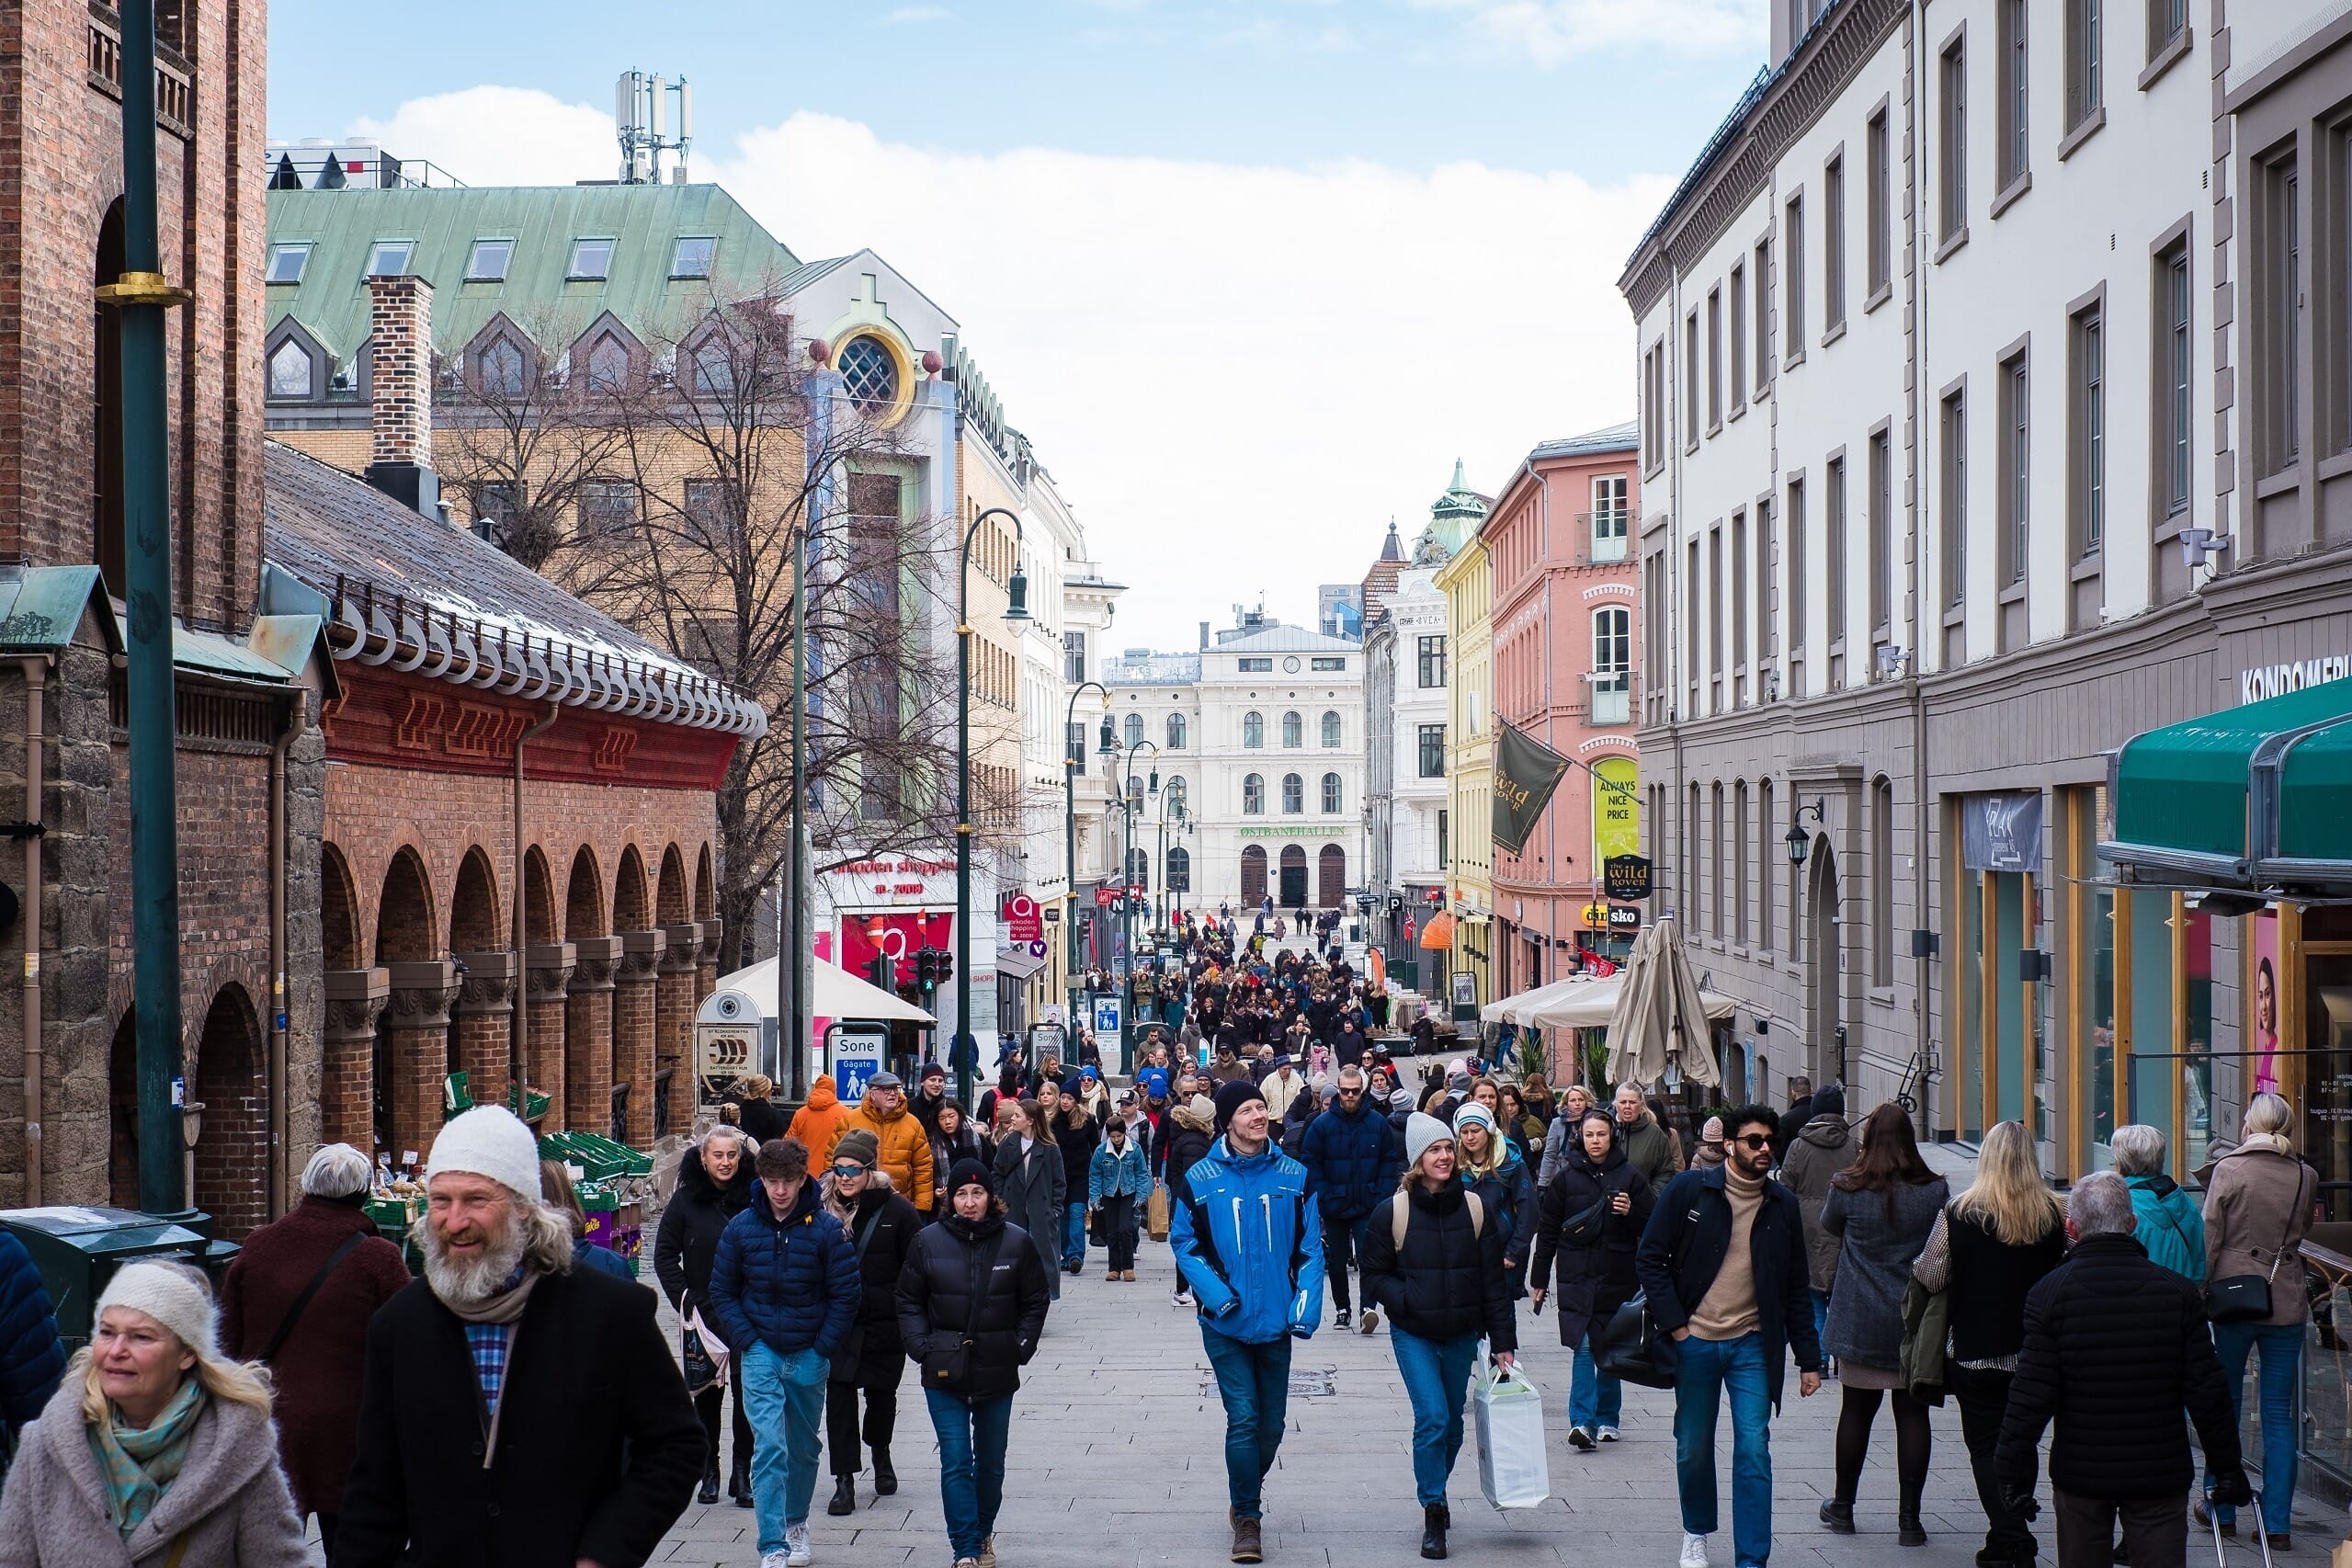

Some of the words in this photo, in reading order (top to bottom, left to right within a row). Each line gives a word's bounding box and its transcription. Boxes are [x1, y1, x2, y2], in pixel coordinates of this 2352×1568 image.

[2243, 653, 2352, 706] KONDOMERI
[1599, 780, 1636, 792] ALWAYS
[1608, 795, 1628, 806] NICE
[1607, 809, 1630, 820] PRICE
[1239, 826, 1346, 837] ØSTBANEHALLEN
[1609, 865, 1647, 880] wild
[1112, 899, 1124, 911] N
[1610, 909, 1635, 923] sko
[972, 974, 995, 983] SHOPS
[839, 1039, 875, 1052] Sone
[843, 1060, 871, 1070] Gågate
